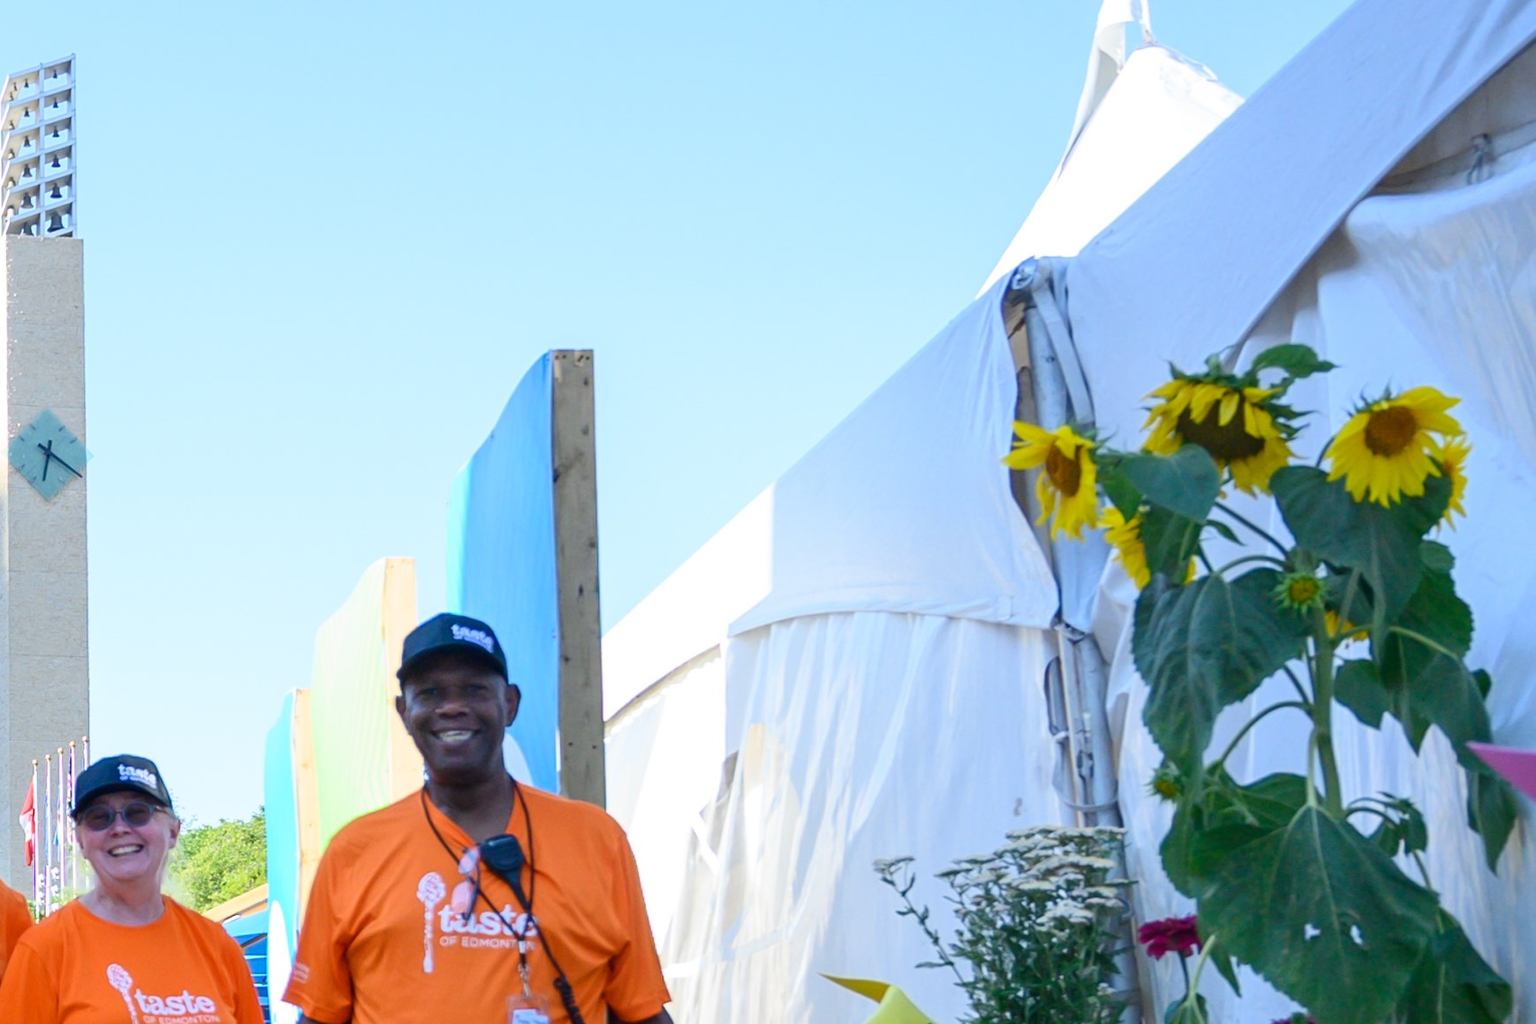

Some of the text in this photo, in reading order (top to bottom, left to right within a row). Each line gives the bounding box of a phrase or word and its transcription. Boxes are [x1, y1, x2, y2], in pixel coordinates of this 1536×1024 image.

[437, 904, 540, 937] taste
[439, 936, 535, 950] OF EDMONTN
[134, 988, 216, 1015] taste
